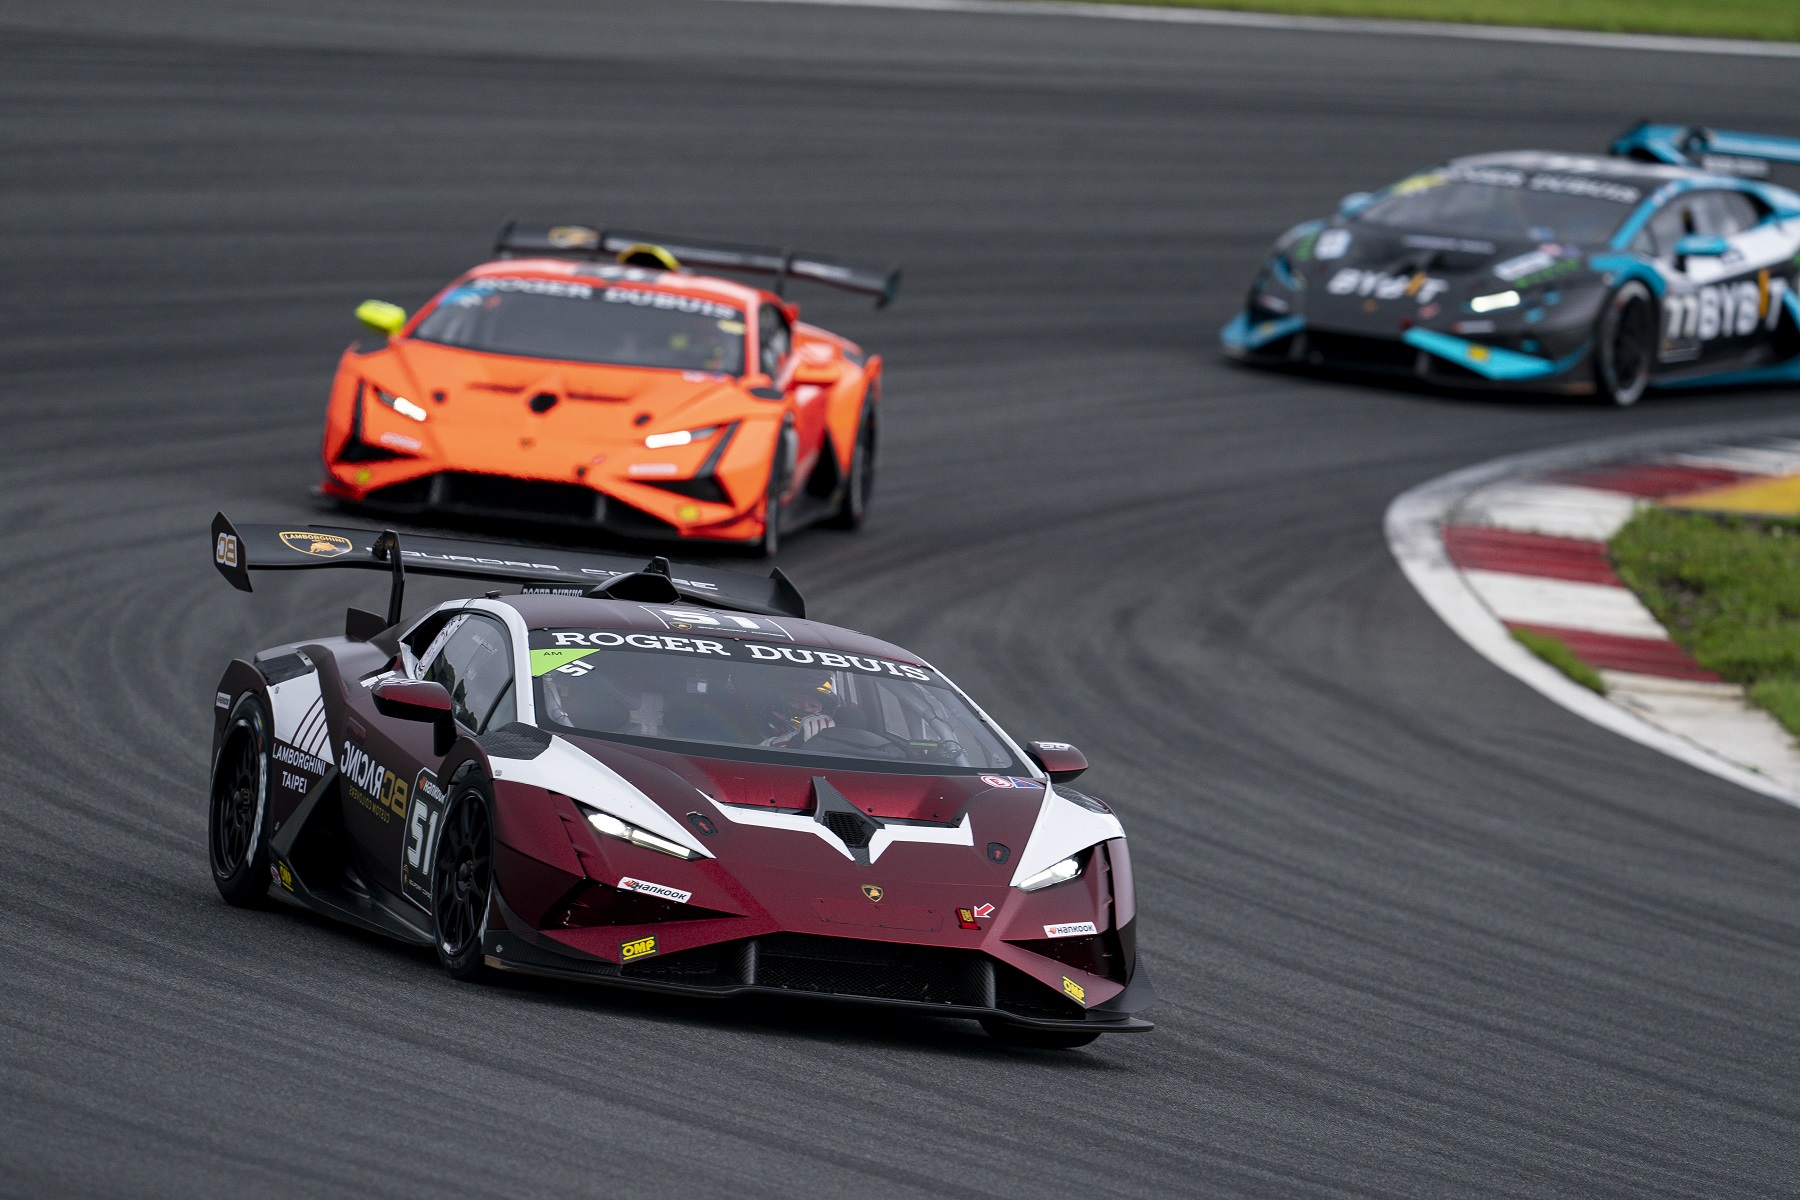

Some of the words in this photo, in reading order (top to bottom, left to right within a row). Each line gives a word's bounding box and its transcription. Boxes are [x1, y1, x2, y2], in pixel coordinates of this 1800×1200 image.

[285, 534, 345, 544] LAMBORGHINI
[660, 609, 761, 629] 51
[555, 631, 731, 656] ROGER
[745, 643, 931, 682] DUBUIS
[556, 660, 596, 677] 51
[272, 742, 327, 777] LAMBORGHINI
[282, 770, 308, 794] TAIPEI
[407, 799, 439, 876] 51
[622, 939, 656, 957] OMP
